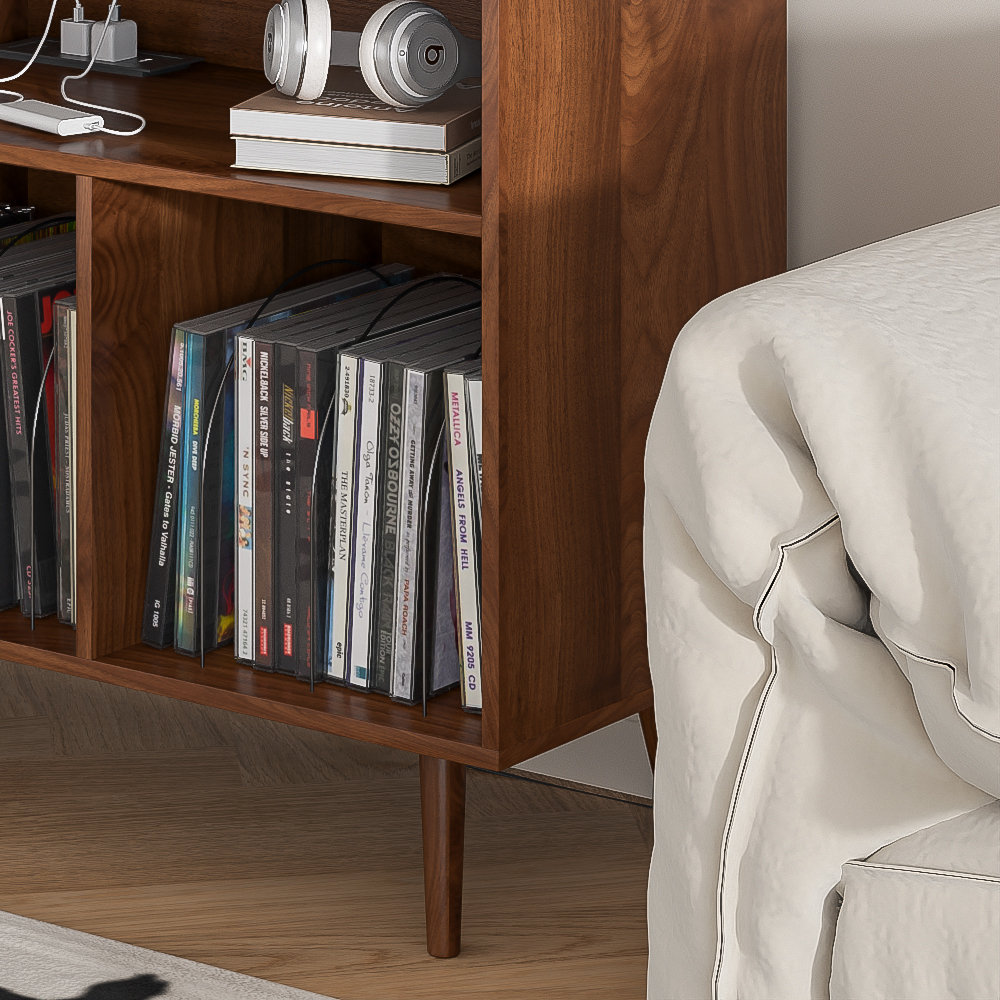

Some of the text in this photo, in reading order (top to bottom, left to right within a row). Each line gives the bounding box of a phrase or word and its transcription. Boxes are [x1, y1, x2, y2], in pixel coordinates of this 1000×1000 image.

[8, 328, 17, 370] COCKER'S
[11, 371, 21, 414] GREATEST
[260, 351, 268, 458] NICKELBACK SILVER SIDE UP
[171, 405, 182, 445] MORBID
[389, 403, 401, 447] OZZY
[167, 447, 177, 484] JESTER
[363, 440, 375, 469] Olga
[162, 491, 173, 518] Gates
[385, 446, 400, 535] OSBOURNE
[162, 520, 170, 530] to
[338, 492, 348, 560] MASTERPLAN
[451, 391, 476, 690] METALLICA ANGELS FROM HELL MM 9205 CD
[158, 532, 169, 567] Valhalla
[382, 540, 395, 588] BLACK
[152, 611, 160, 628] 1005
[154, 599, 161, 609] IG
[379, 629, 387, 664] EDITION
